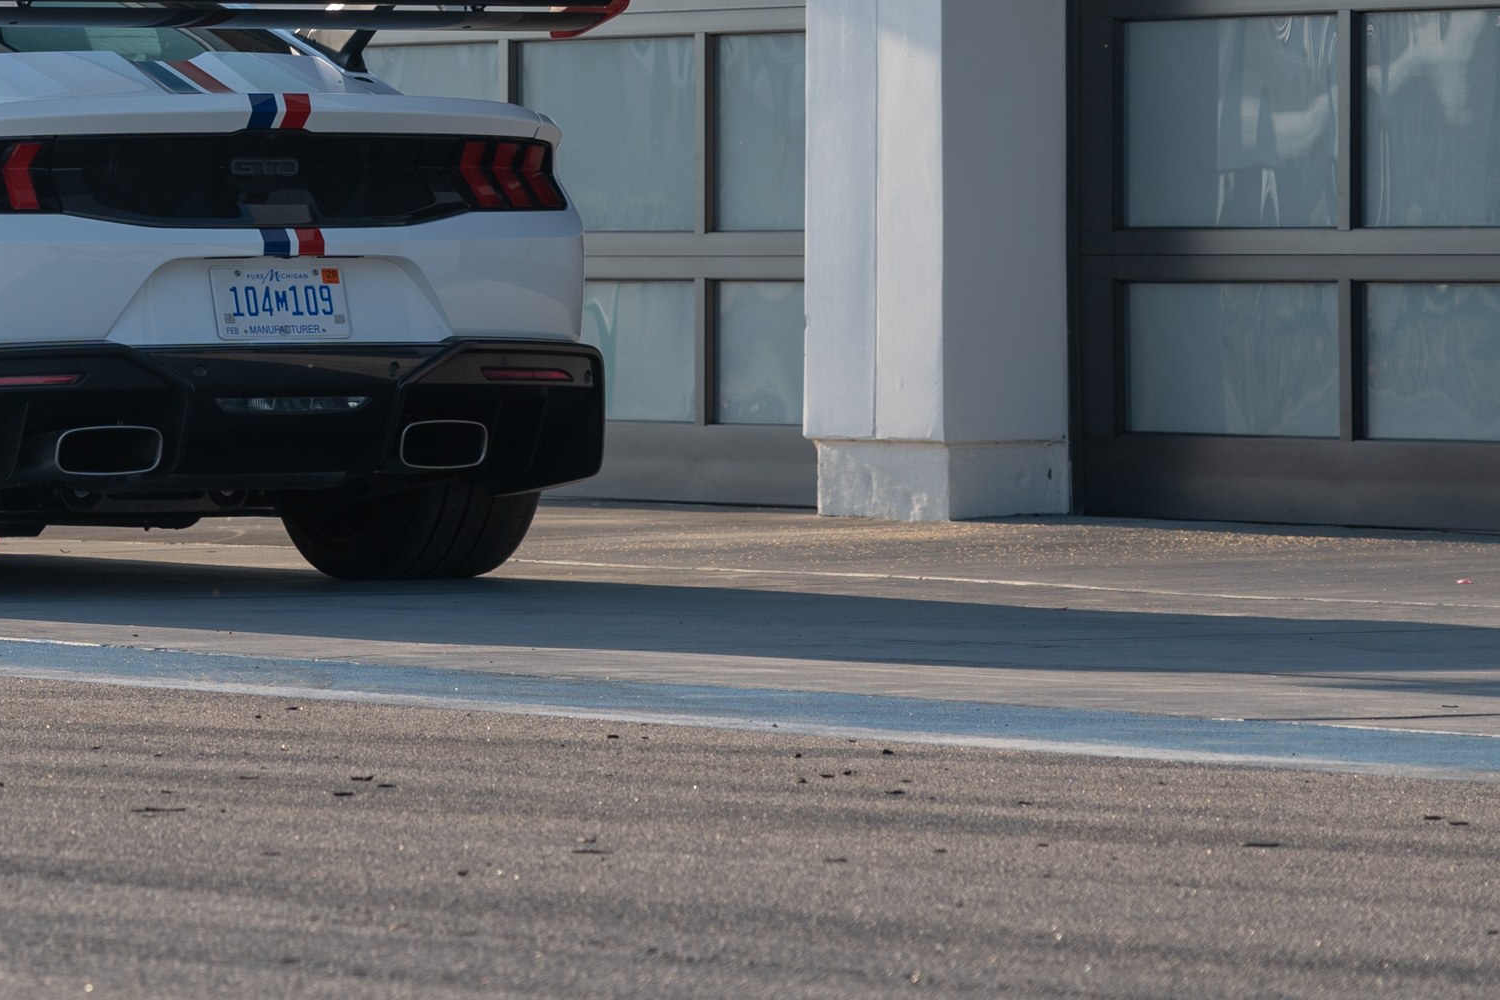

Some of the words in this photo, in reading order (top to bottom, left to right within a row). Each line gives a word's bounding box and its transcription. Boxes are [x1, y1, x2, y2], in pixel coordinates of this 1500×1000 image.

[231, 159, 299, 175] GTD
[262, 269, 308, 284] MICHIGAN
[326, 270, 338, 279] 28
[229, 285, 334, 317] 104M109
[249, 325, 321, 334] MANUFACTURER
